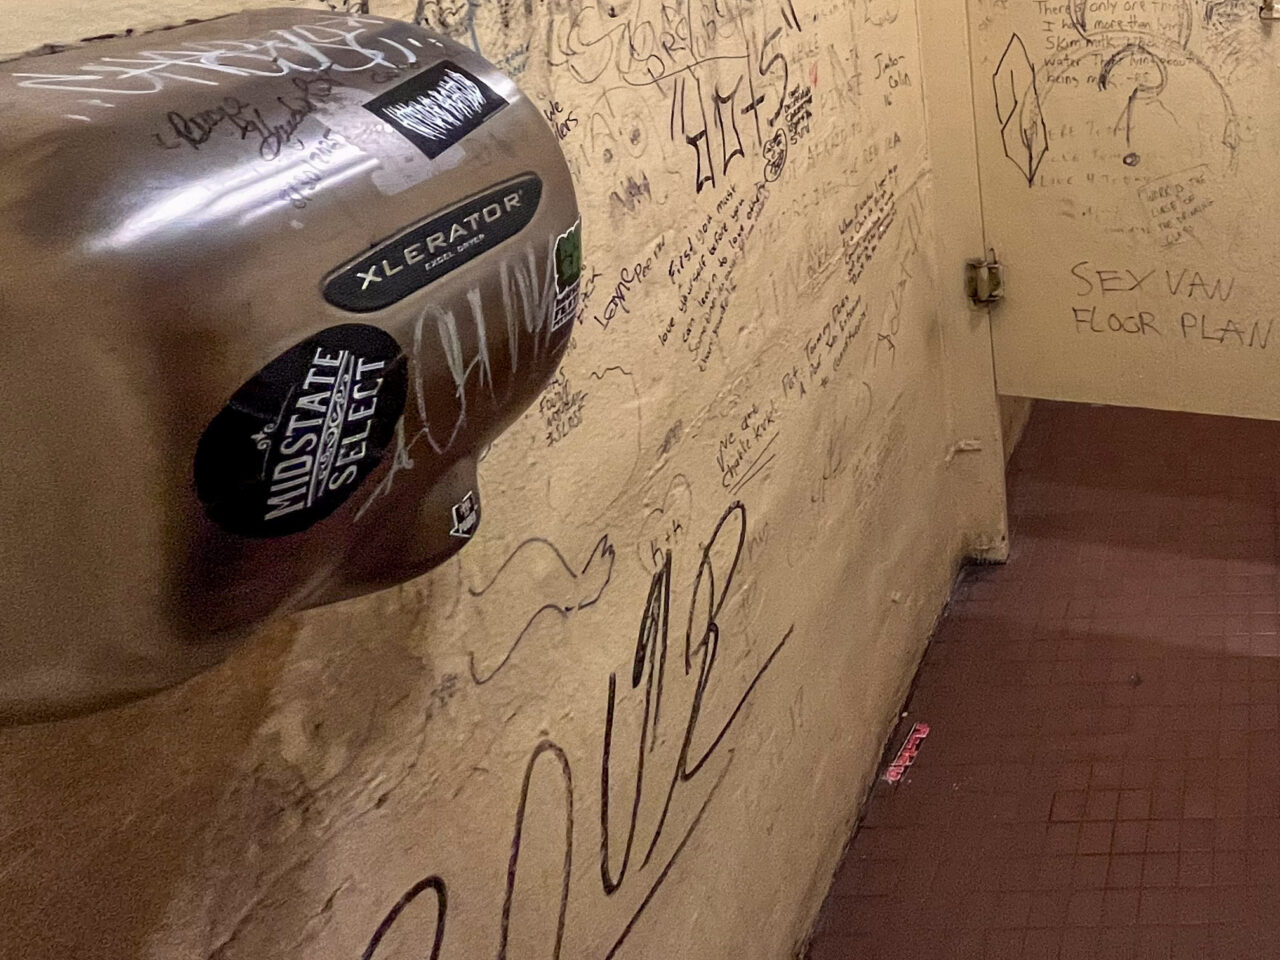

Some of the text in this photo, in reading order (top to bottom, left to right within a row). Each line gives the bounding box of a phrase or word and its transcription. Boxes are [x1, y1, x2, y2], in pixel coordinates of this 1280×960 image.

[356, 191, 522, 291] XLERATOR
[1071, 261, 1236, 303] SEX VAN
[1072, 306, 1274, 350] FLOOR PLAN
[264, 346, 344, 521] MIDSTATE
[329, 357, 386, 491] SELECT
